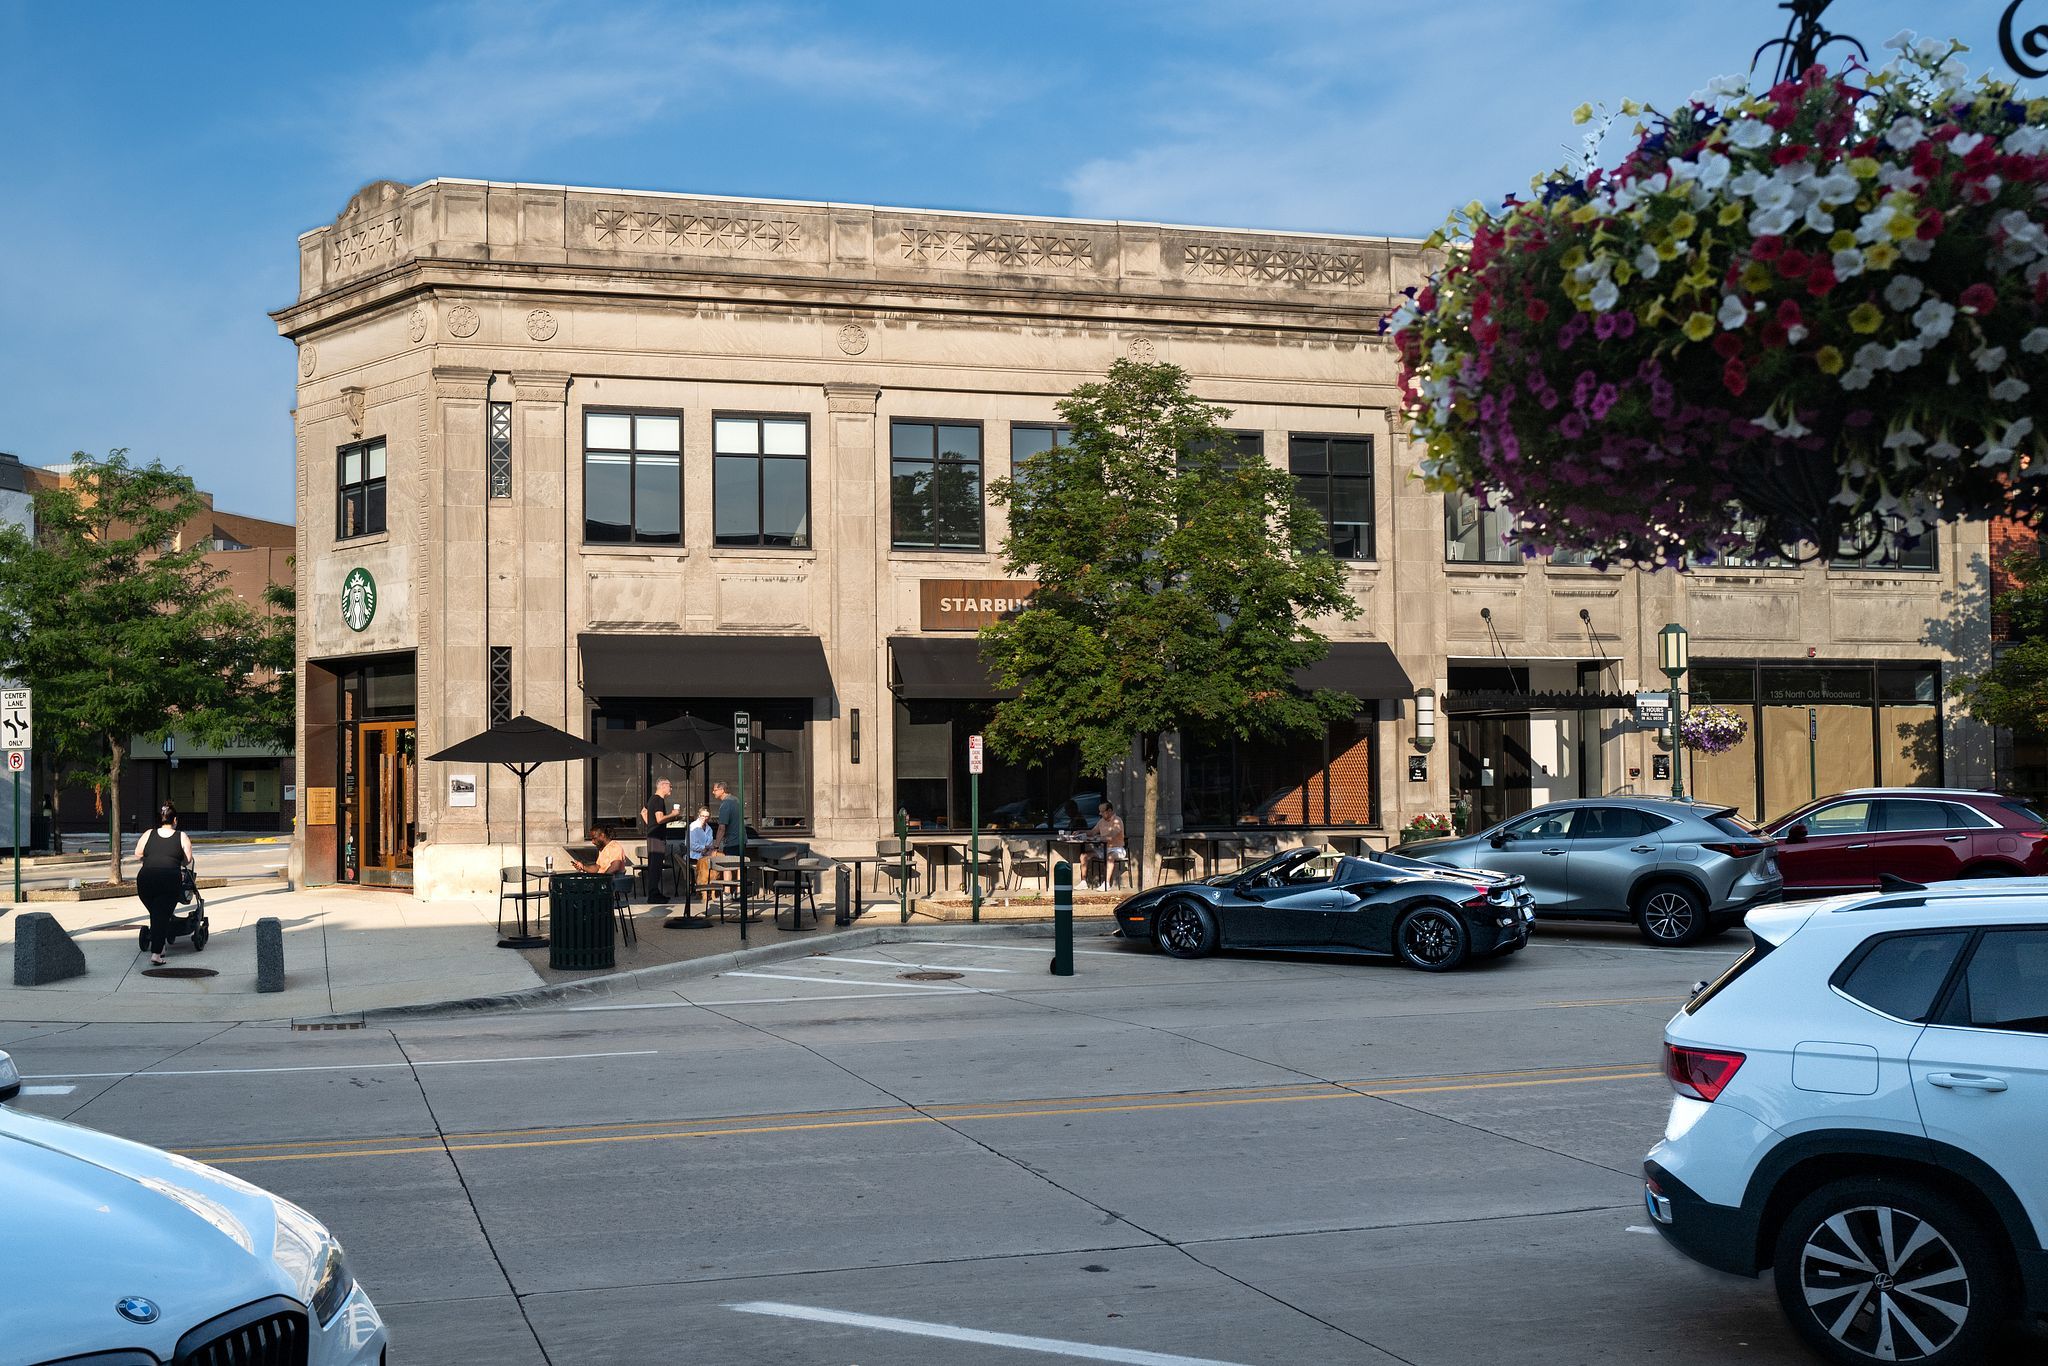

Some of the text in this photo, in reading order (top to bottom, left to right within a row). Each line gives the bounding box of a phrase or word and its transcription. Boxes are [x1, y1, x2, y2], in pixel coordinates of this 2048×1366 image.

[940, 597, 1036, 612] STARBUC
[4, 692, 27, 700] CENTER
[1770, 690, 1861, 699] 135 North Old Woodward
